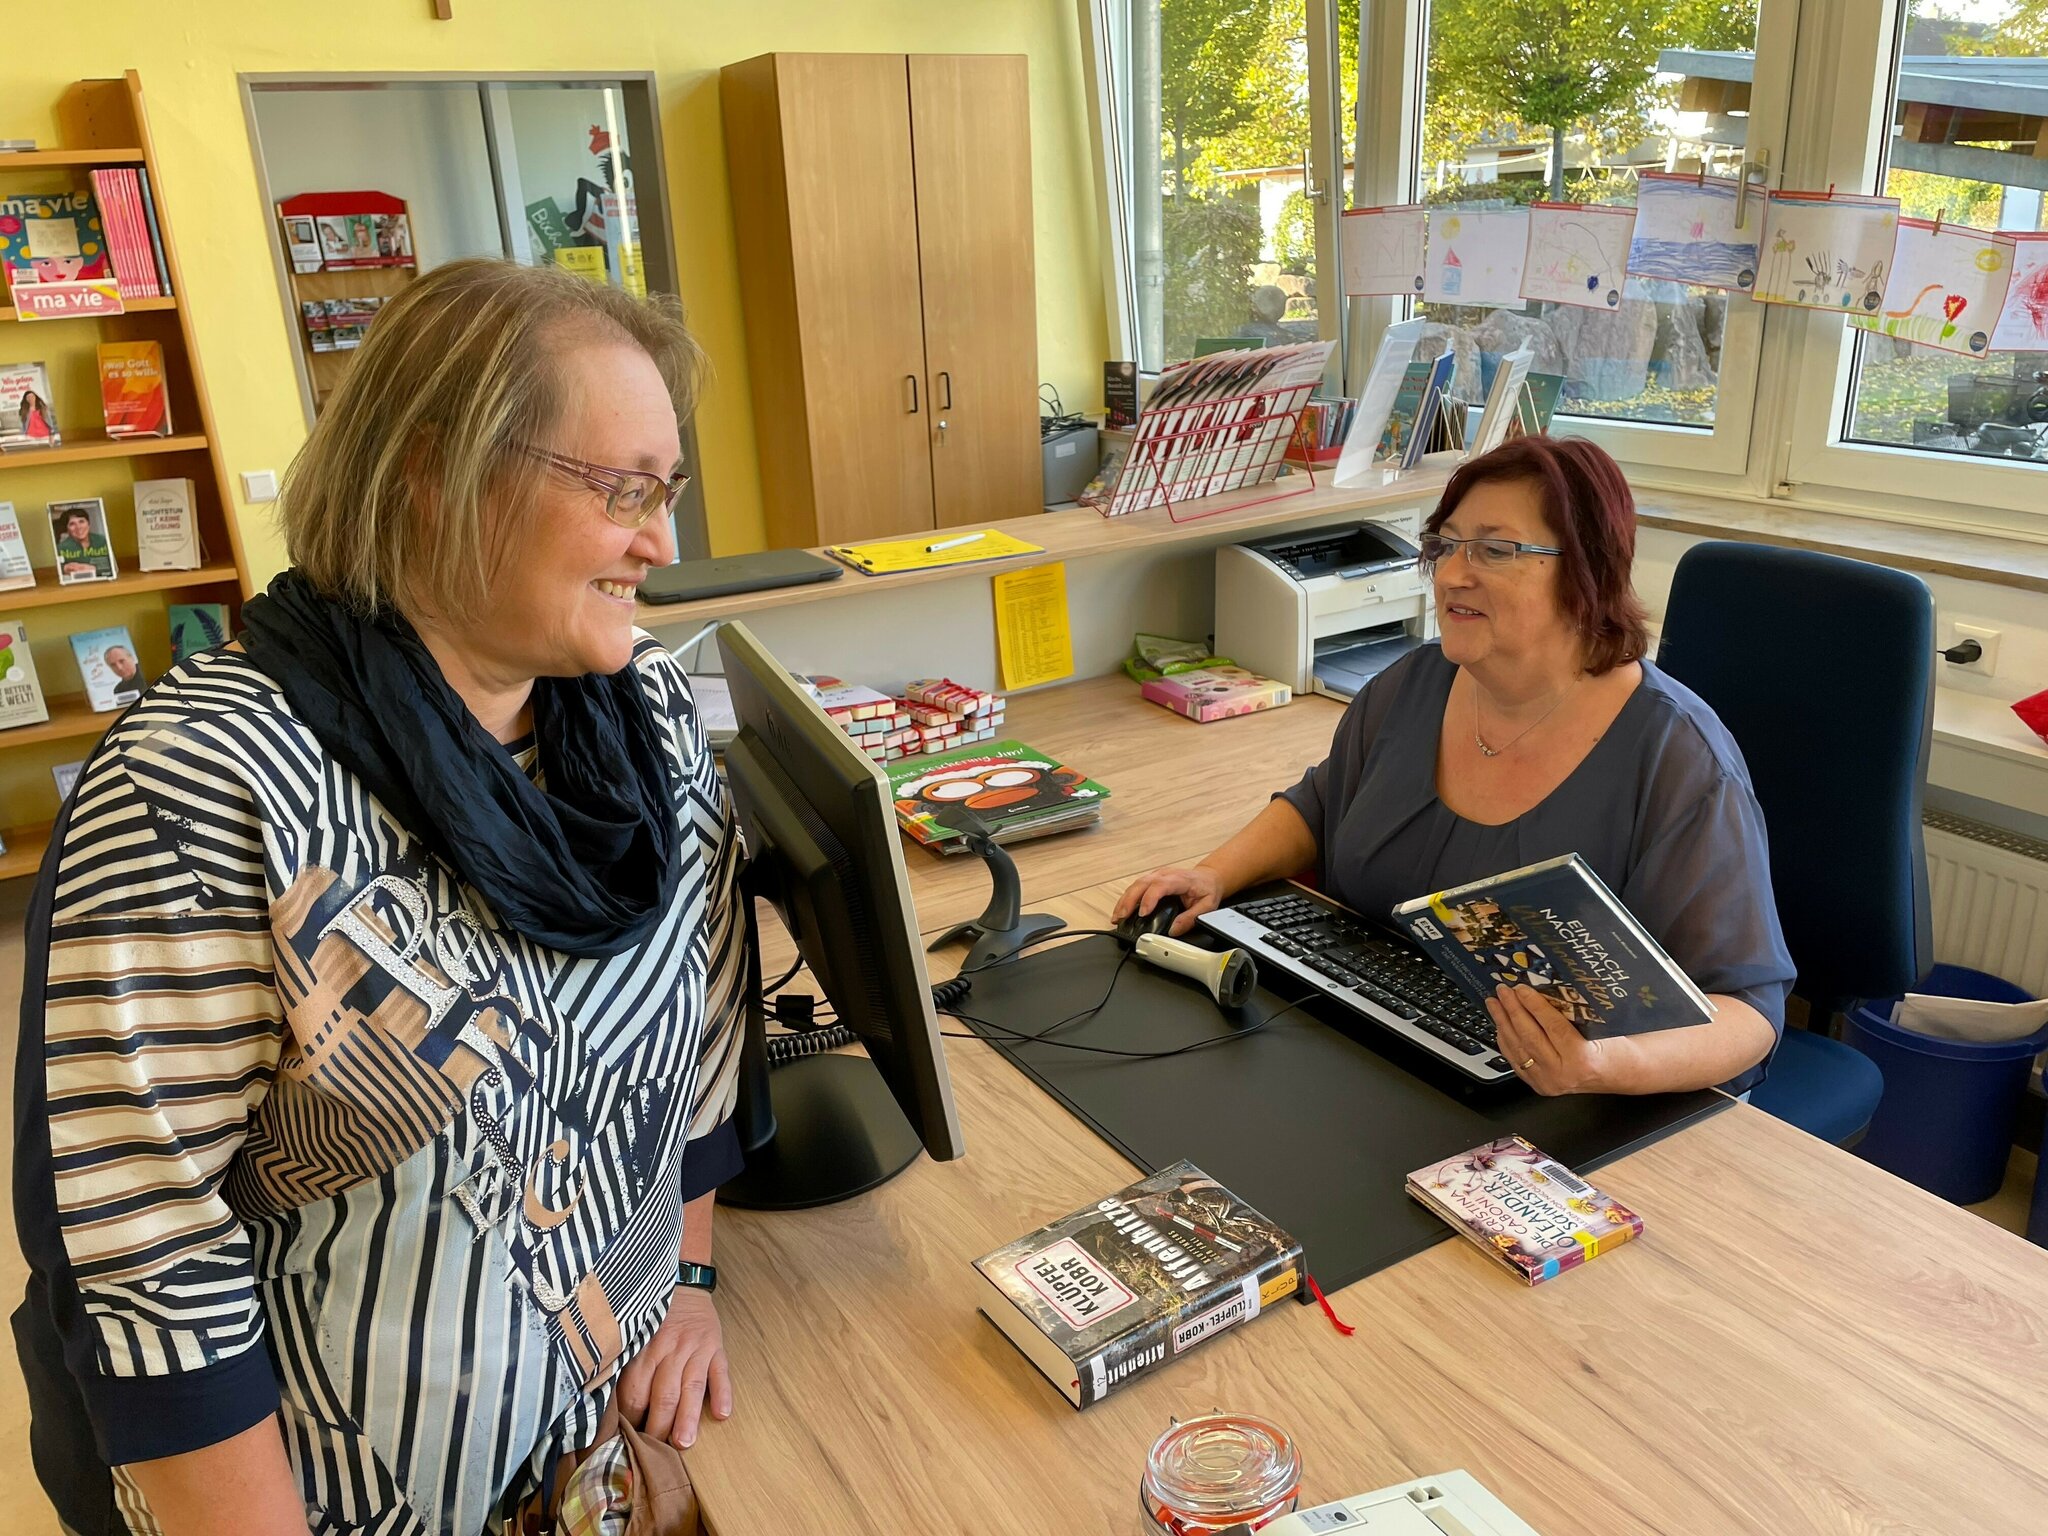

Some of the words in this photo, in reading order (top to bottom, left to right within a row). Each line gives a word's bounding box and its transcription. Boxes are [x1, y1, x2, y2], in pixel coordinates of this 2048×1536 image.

[0, 198, 41, 216] ma
[48, 193, 88, 212] vie
[33, 293, 67, 310] ma
[69, 287, 103, 307] vie
[127, 358, 150, 369] Gott
[142, 507, 183, 517] NICHTSTUN
[60, 548, 81, 559] Nur
[1419, 918, 1440, 938] EMF
[1539, 908, 1628, 1000] NACHHALTIG
[1567, 919, 1630, 982] EINFACH
[1450, 1190, 1505, 1233] CRISTINA
[1475, 1196, 1528, 1234] CABONI
[1483, 1181, 1578, 1249] OLEANDER
[1493, 1171, 1579, 1231] SCHWESTERN
[1097, 1199, 1213, 1292] Affenhitze
[1530, 1234, 1554, 1250] DIE
[1030, 1256, 1099, 1317] KLÜPFEL
[1060, 1255, 1111, 1298] KOBR
[1178, 1321, 1205, 1343] KOBR
[1107, 1341, 1165, 1385] Affenhit
